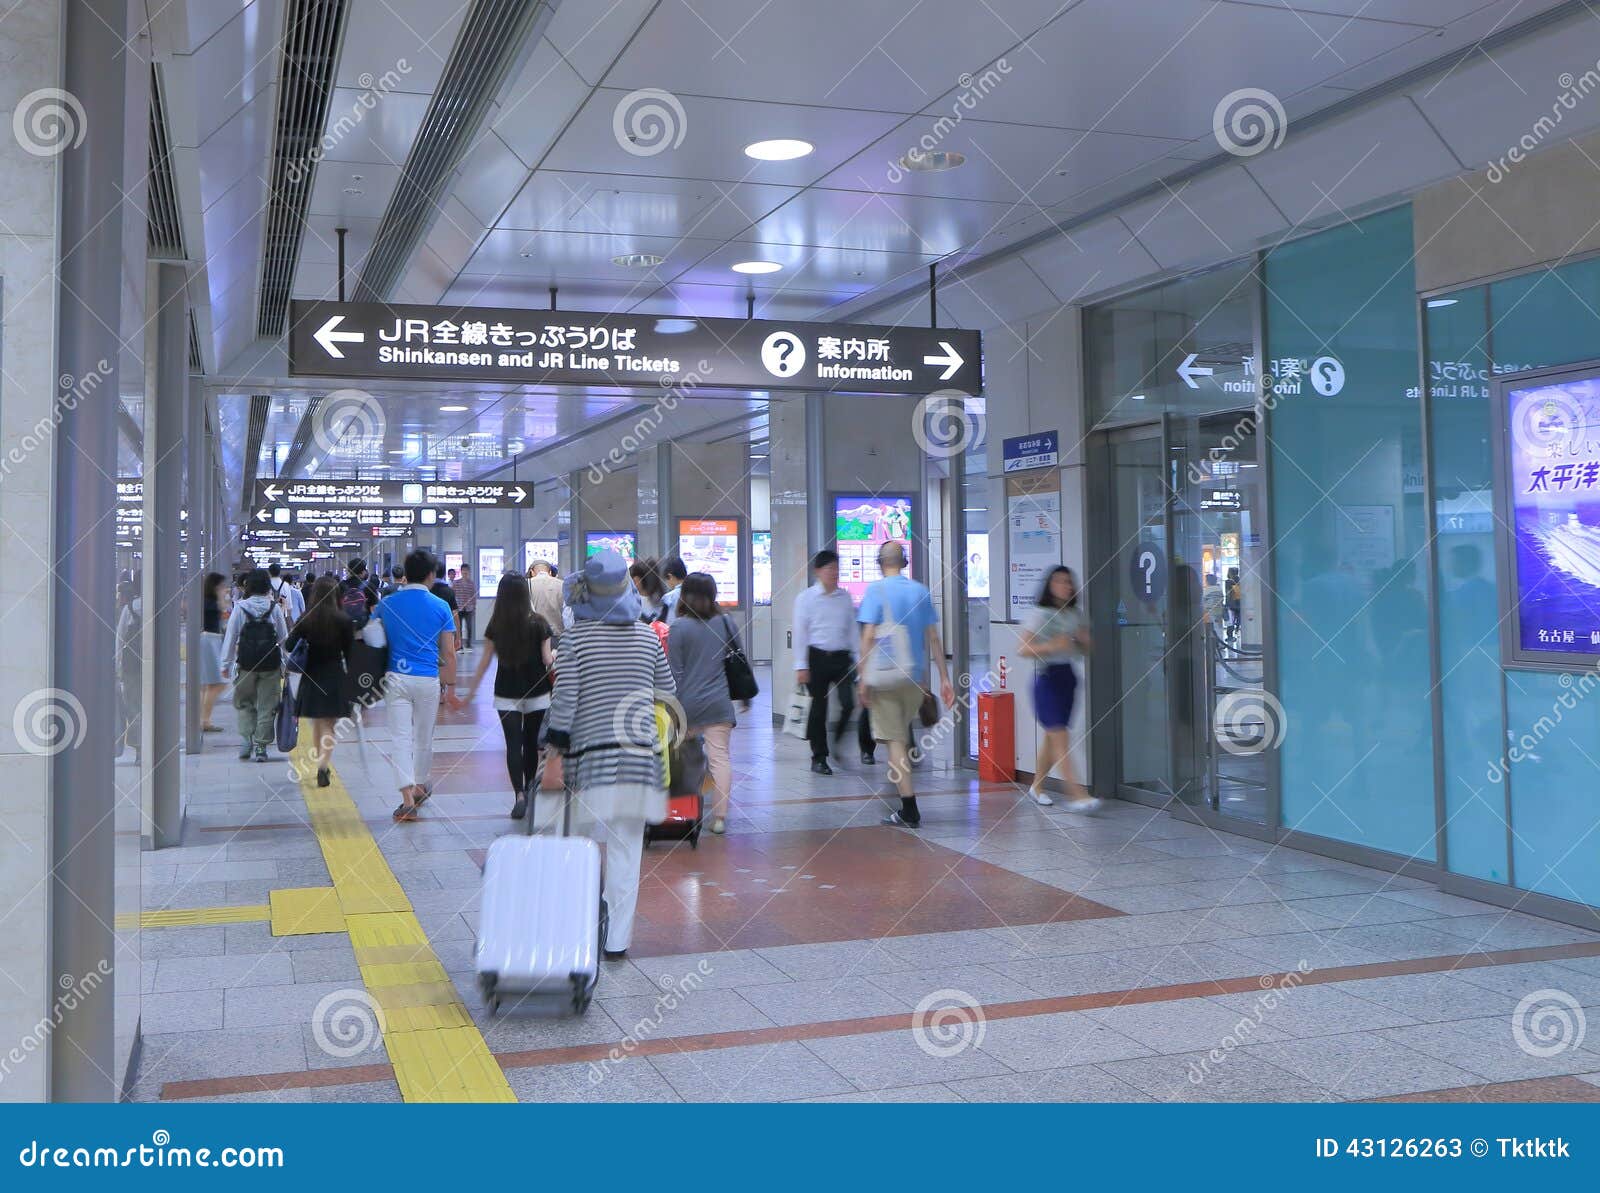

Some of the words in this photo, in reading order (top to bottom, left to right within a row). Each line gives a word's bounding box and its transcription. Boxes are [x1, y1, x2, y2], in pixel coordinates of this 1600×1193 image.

[379, 318, 637, 350] JR全線きっぷうりば
[379, 346, 492, 366] Shinkansen
[498, 352, 533, 367] and
[539, 352, 564, 368] JR
[569, 353, 609, 370] Line
[614, 355, 680, 373] Tickets
[817, 336, 890, 361] 案内所
[817, 363, 912, 381] Information
[1527, 461, 1600, 493] 太平洋
